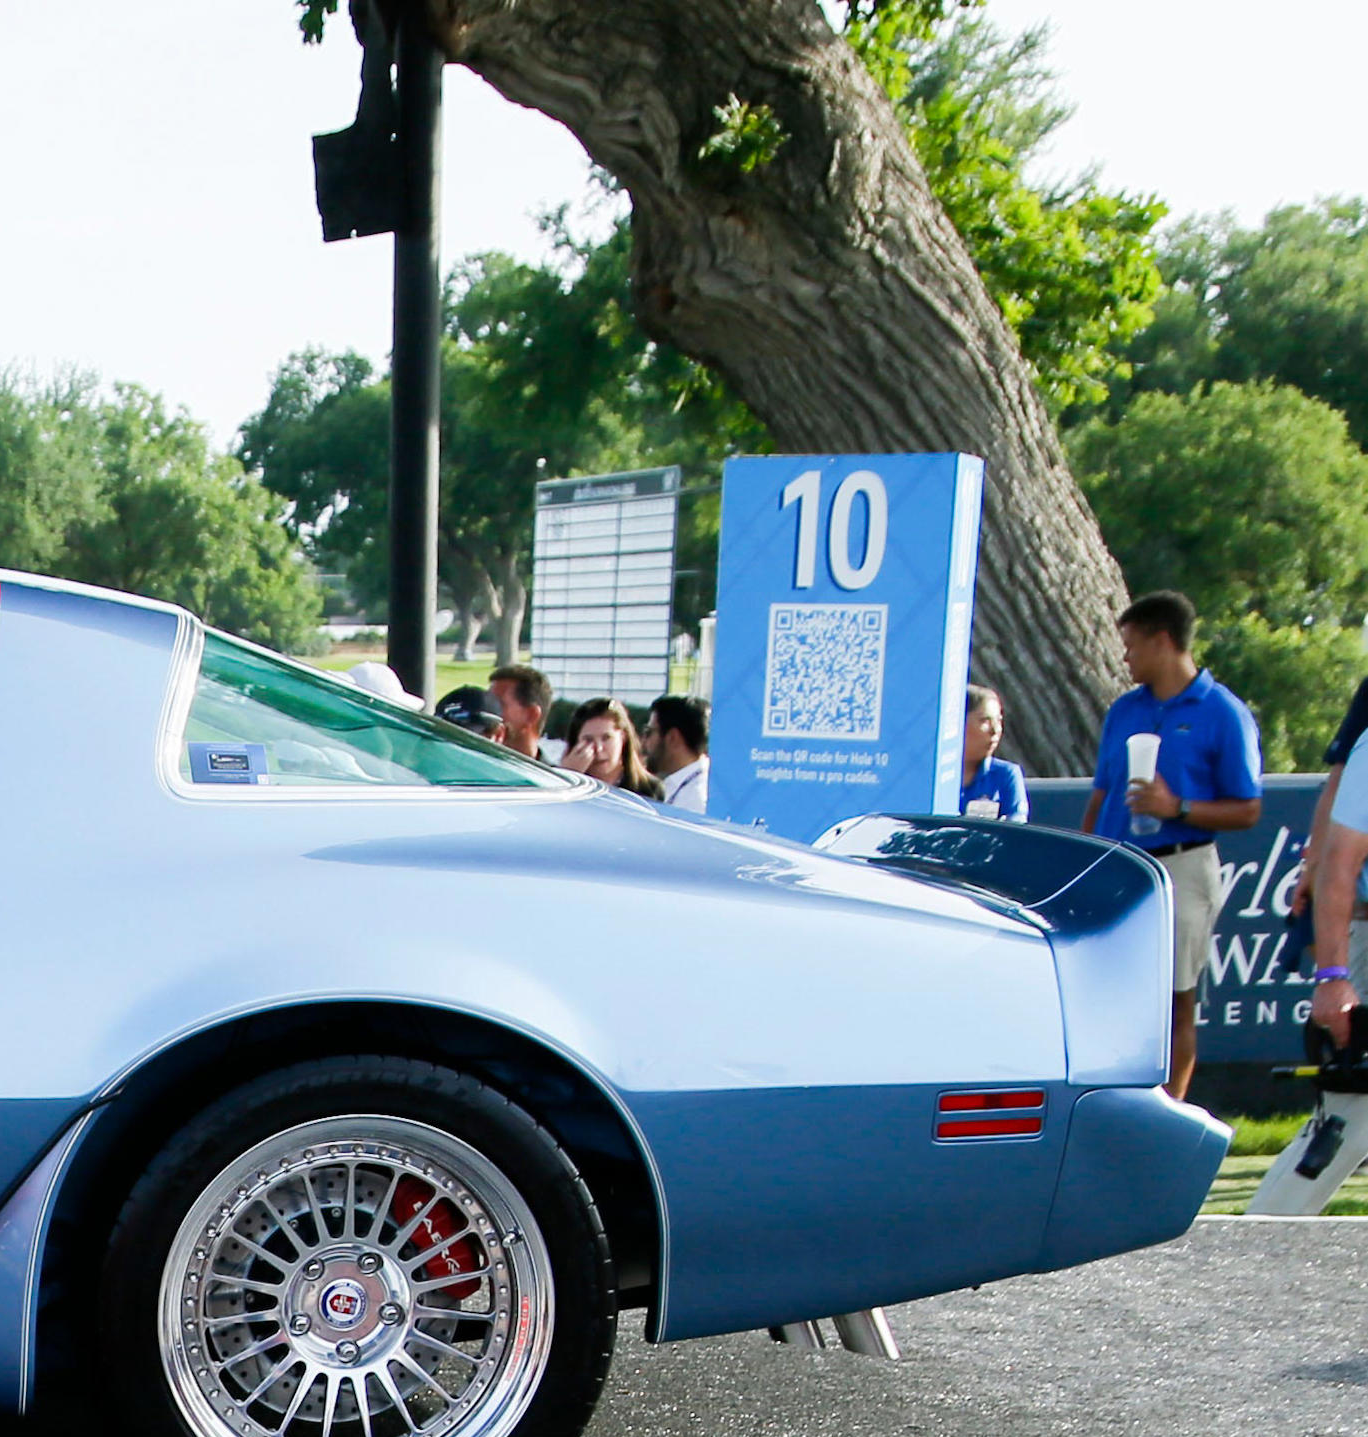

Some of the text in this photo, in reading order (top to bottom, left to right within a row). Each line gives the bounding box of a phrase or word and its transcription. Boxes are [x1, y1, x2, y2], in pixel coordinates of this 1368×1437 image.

[780, 469, 889, 591] 10
[750, 748, 889, 766] Scan the QR code for Hole 10
[795, 767, 817, 781] from
[826, 771, 843, 784] pro
